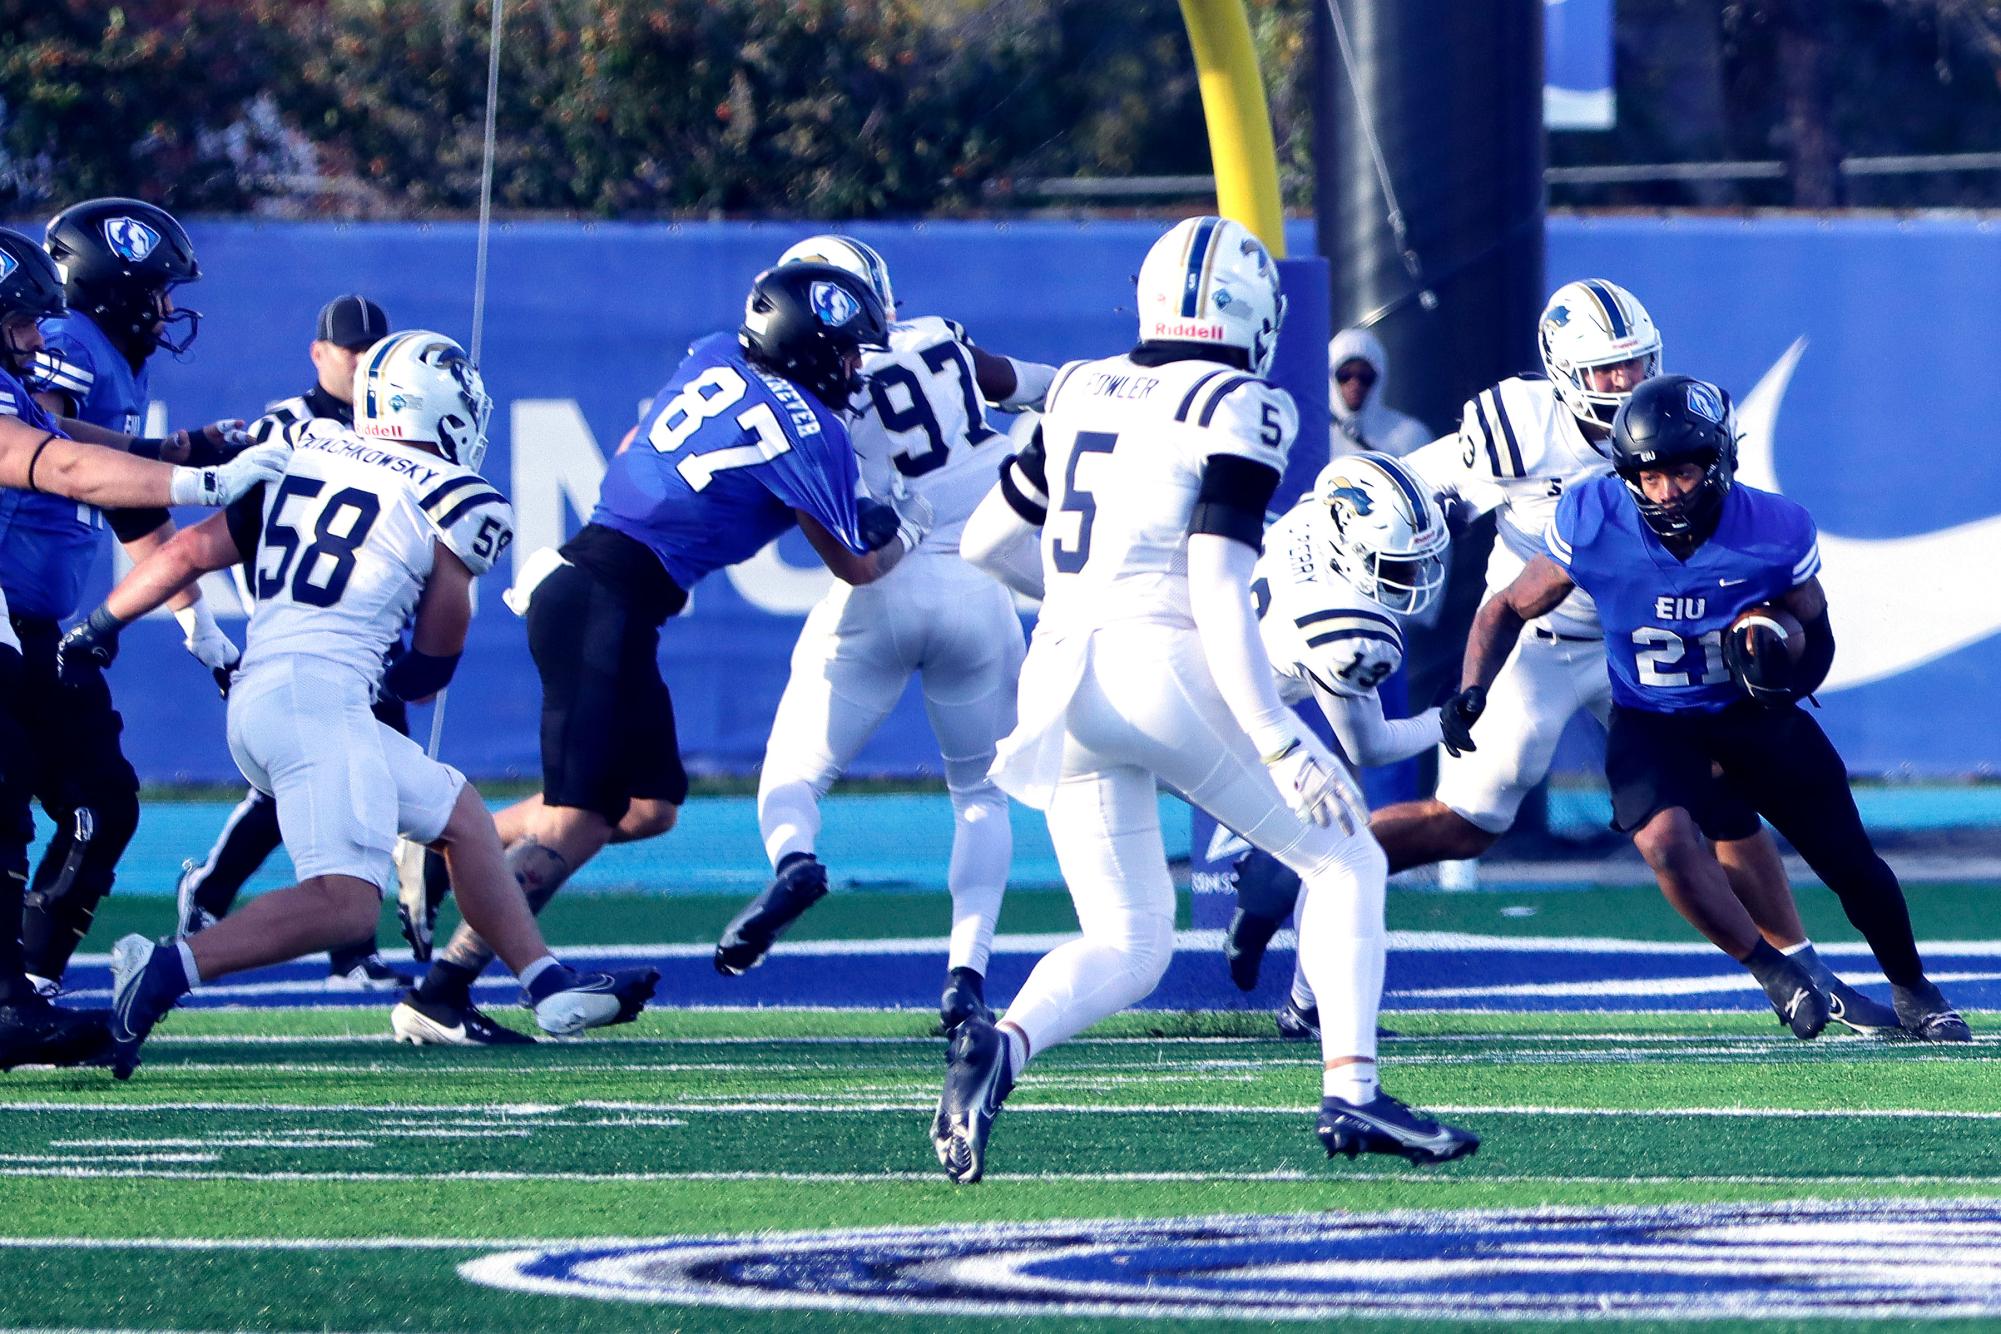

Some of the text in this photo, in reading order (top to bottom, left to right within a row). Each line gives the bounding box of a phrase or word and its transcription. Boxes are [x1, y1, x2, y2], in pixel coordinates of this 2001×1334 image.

[1155, 322, 1224, 340] Riddell
[868, 340, 998, 477] 97
[1083, 372, 1160, 399] FOWLER
[648, 366, 791, 493] 87
[1260, 402, 1282, 448] 5
[1053, 431, 1119, 573] 5
[257, 475, 380, 608] 58
[1655, 596, 1706, 620] EIU
[1631, 626, 1731, 687] 21
